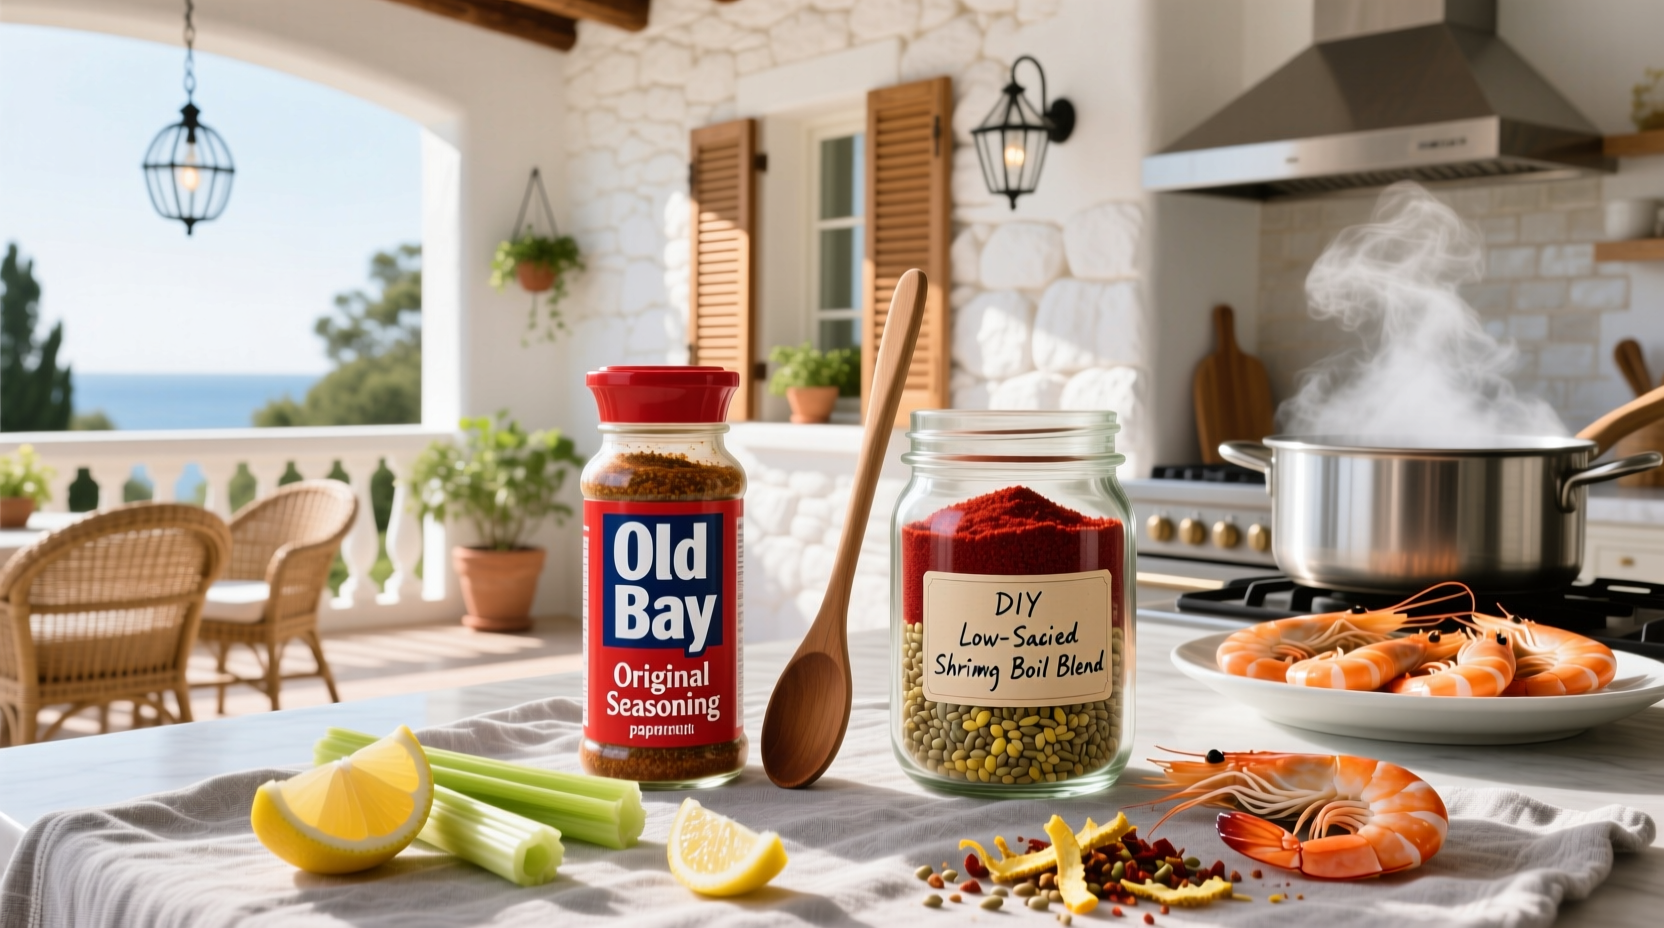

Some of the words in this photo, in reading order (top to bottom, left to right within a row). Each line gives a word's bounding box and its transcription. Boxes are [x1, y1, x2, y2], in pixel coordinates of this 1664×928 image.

[613, 520, 708, 581] Old
[614, 584, 718, 653] Bay
[995, 590, 1043, 618] DIY
[613, 660, 710, 695] Original
[1010, 655, 1050, 680] Boil
[1056, 649, 1105, 678] Blend
[606, 690, 721, 722] Seasoning
